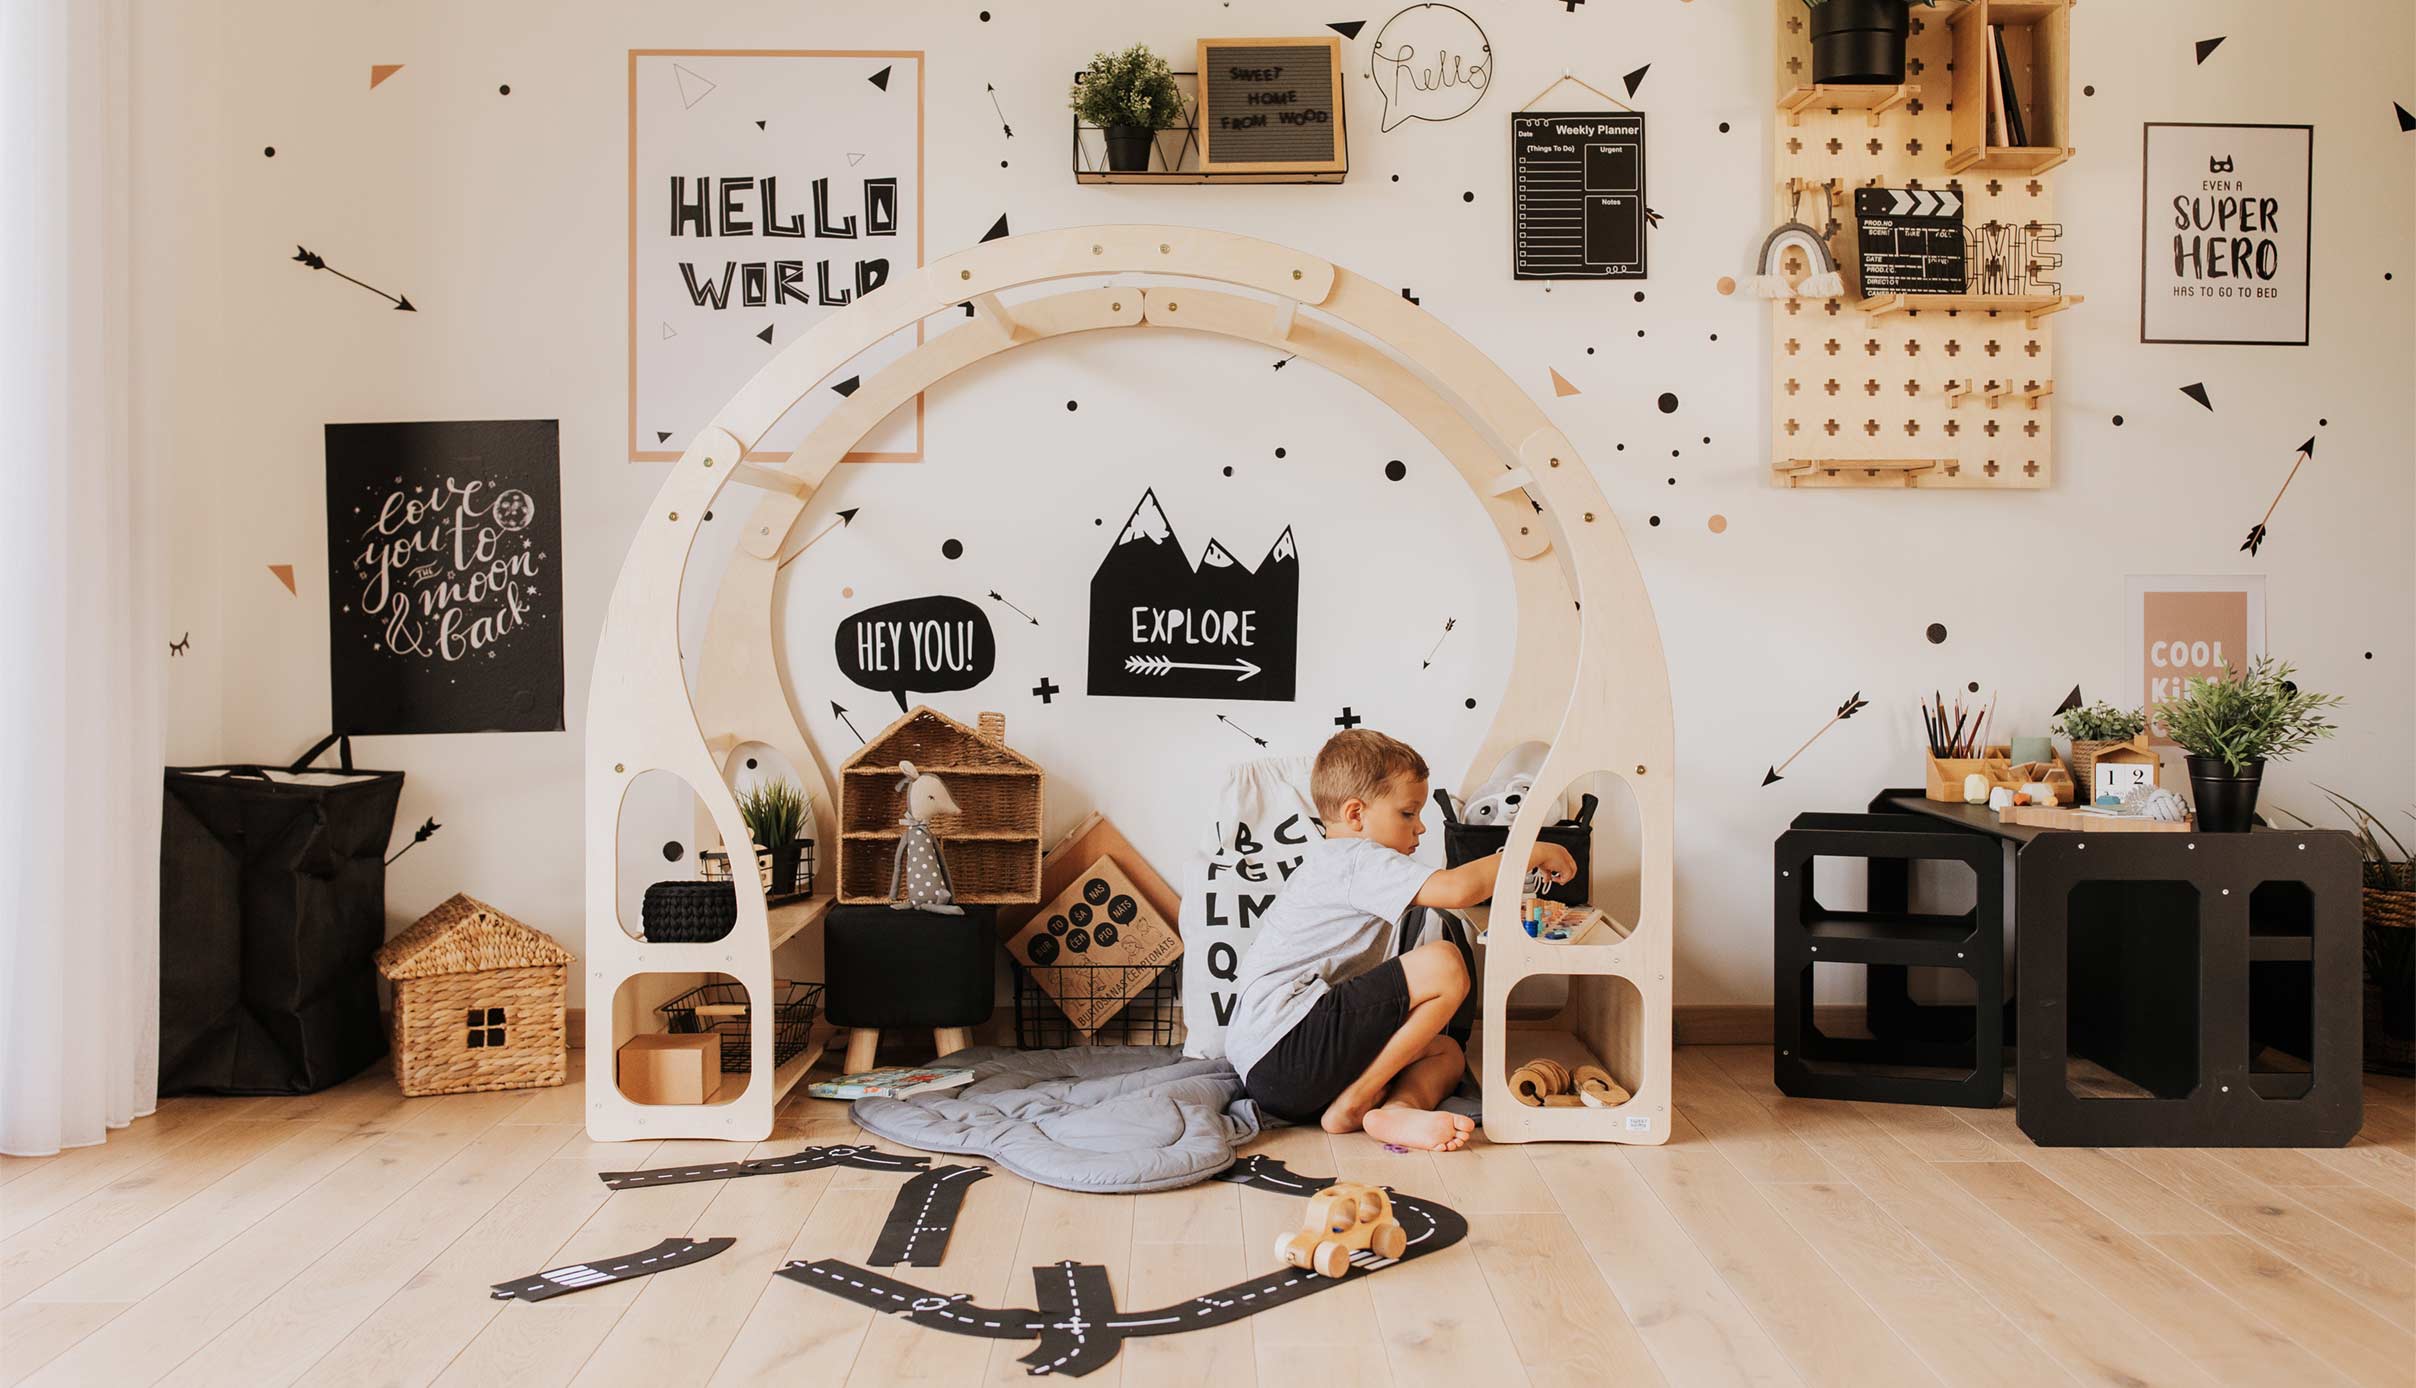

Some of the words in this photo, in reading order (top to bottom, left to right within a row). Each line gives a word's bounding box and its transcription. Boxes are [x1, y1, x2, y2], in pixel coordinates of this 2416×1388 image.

[1230, 66, 1284, 82] SWEET
[1391, 44, 1487, 106] hello
[1247, 90, 1298, 105] HOME
[1220, 114, 1268, 130] FROM
[1278, 108, 1328, 126] WOOD
[1518, 130, 1534, 138] Date
[1556, 124, 1595, 137] Weekly
[1597, 124, 1639, 136] Planner
[1527, 145, 1552, 153] (Things
[1562, 145, 1575, 153] Do)
[1600, 146, 1623, 154] Urgent
[2202, 180, 2231, 191] EVEN
[2235, 180, 2243, 191] A
[670, 175, 898, 240] HELLO
[1601, 198, 1621, 206] Notes
[2173, 195, 2279, 234] SUPER
[2173, 234, 2278, 281] HERO
[677, 257, 890, 311] WORLD
[2173, 286, 2195, 297] HAS
[2200, 286, 2214, 297] TO
[2218, 286, 2233, 297] GO
[2238, 287, 2252, 298] TO
[2256, 287, 2278, 298] BED
[361, 476, 496, 540] love
[354, 524, 447, 614] you
[445, 505, 506, 571] to
[415, 567, 434, 579] THE
[419, 551, 539, 616] moon
[386, 592, 433, 657] &
[435, 581, 531, 661] back
[1130, 605, 1257, 648] EXPLORE
[856, 619, 903, 672] HEY
[909, 619, 975, 672] YOU!
[2151, 640, 2228, 668] COOL
[1206, 892, 1228, 926] L
[1051, 920, 1064, 931] TO
[1098, 927, 1114, 943] PIO
[1207, 942, 1238, 983] Q
[1210, 992, 1238, 1026] V
